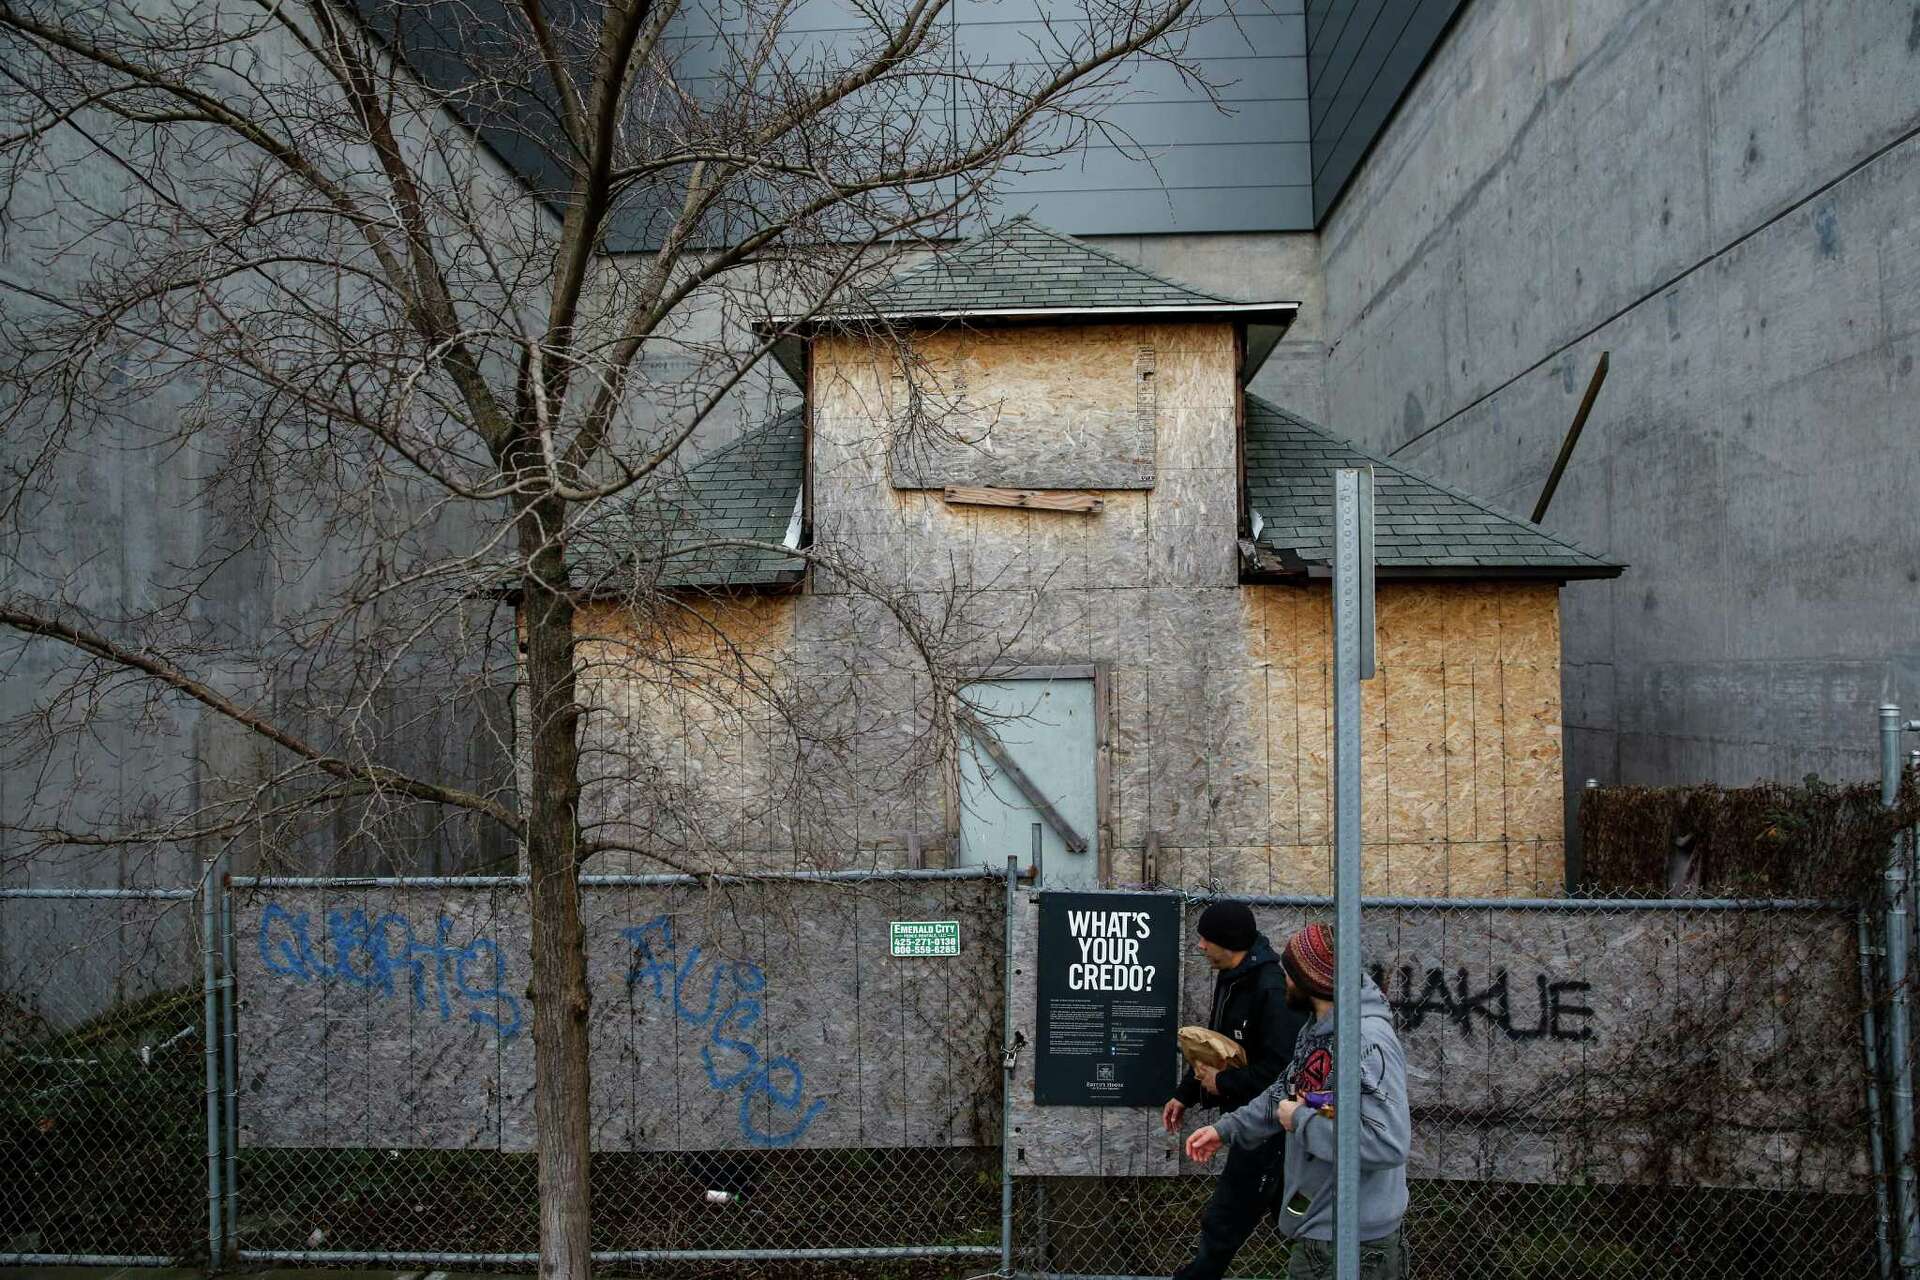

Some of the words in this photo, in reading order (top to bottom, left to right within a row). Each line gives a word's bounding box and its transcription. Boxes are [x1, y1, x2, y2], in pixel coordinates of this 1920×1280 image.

[894, 924, 934, 934] EMERALD
[936, 924, 955, 934] CITY
[1067, 910, 1151, 939] WHAT'S
[1078, 937, 1139, 965] YOUR
[1069, 963, 1156, 992] CREDO?
